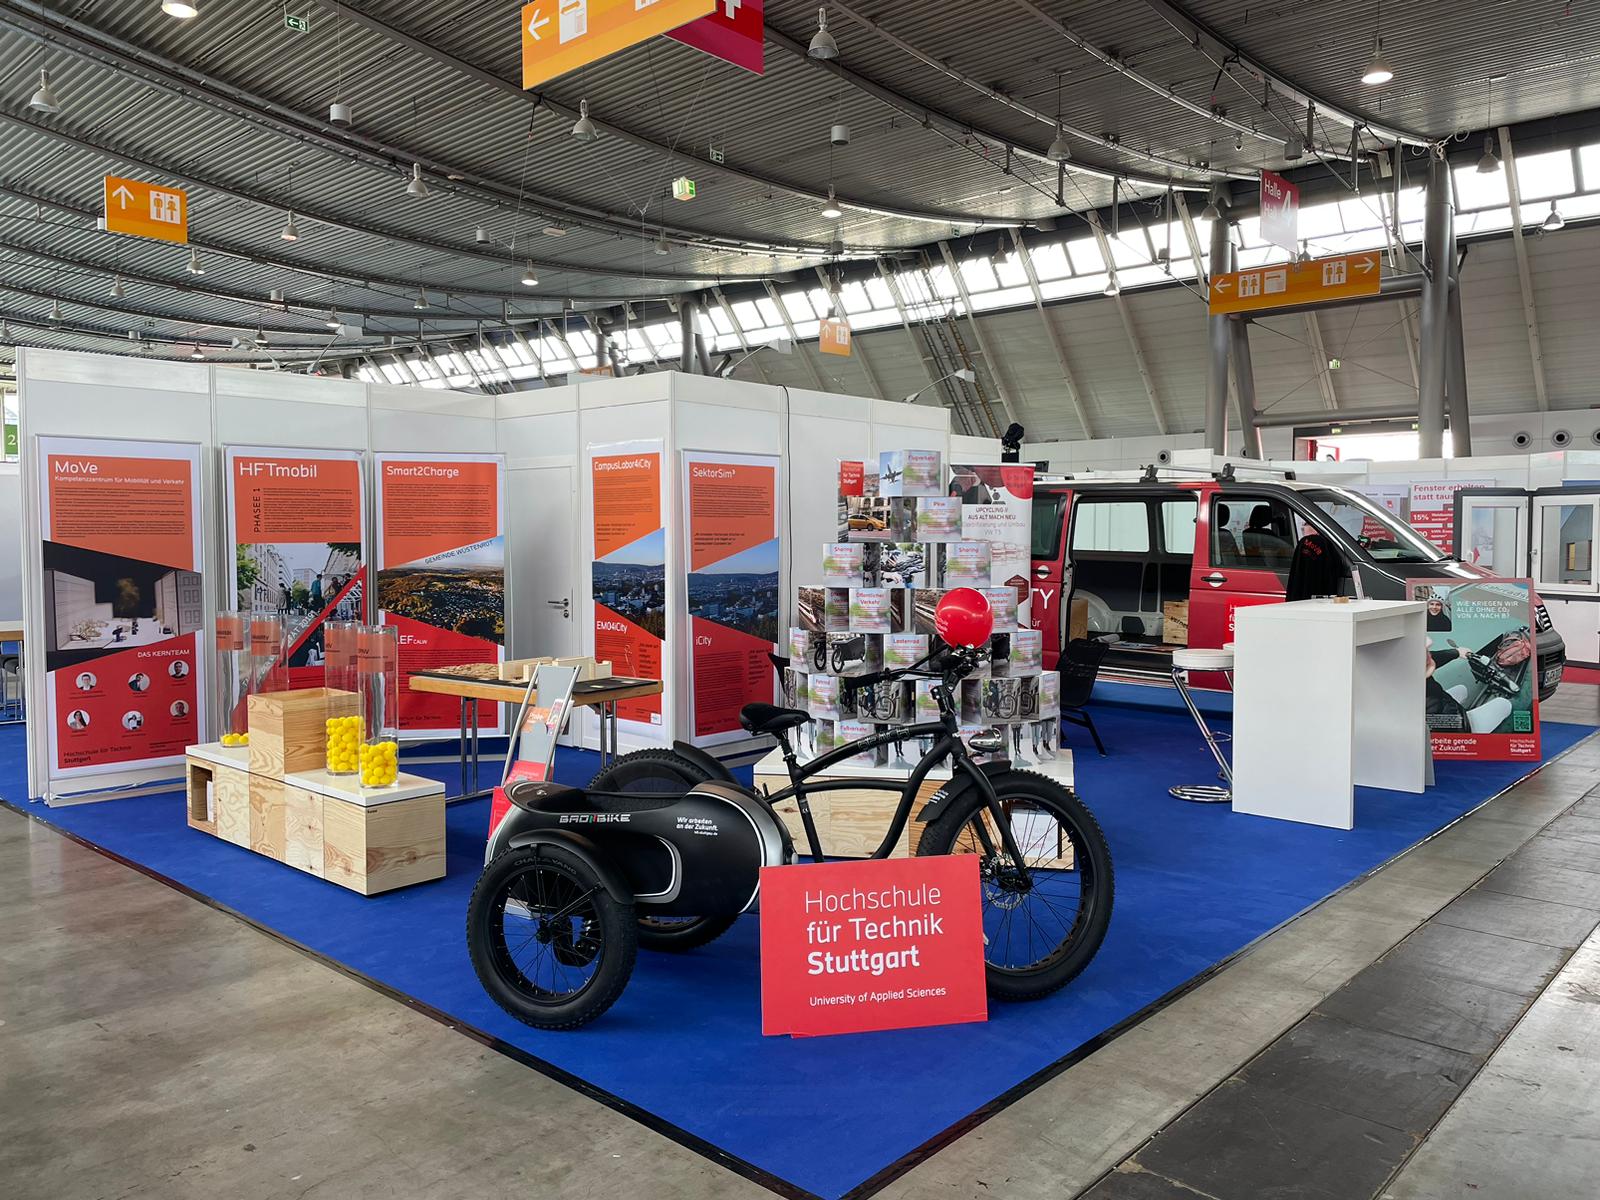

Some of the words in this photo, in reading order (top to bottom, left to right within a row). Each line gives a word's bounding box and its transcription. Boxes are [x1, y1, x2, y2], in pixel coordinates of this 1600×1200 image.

[1264, 178, 1281, 200] Halle
[55, 461, 98, 474] MoVe
[240, 462, 317, 478] HFTmobil
[386, 465, 460, 478] Smart2Charge
[1414, 484, 1446, 492] Fenster
[695, 635, 712, 646] iCity
[152, 649, 190, 658] KERNTEAM
[805, 883, 941, 914] Hochschule
[806, 920, 842, 945] für
[848, 912, 944, 941] Technik
[807, 945, 920, 976] Stuttgart
[809, 993, 856, 1008] University
[858, 991, 868, 1002] of
[869, 988, 904, 1002] Applied
[906, 986, 946, 998] Sciences
